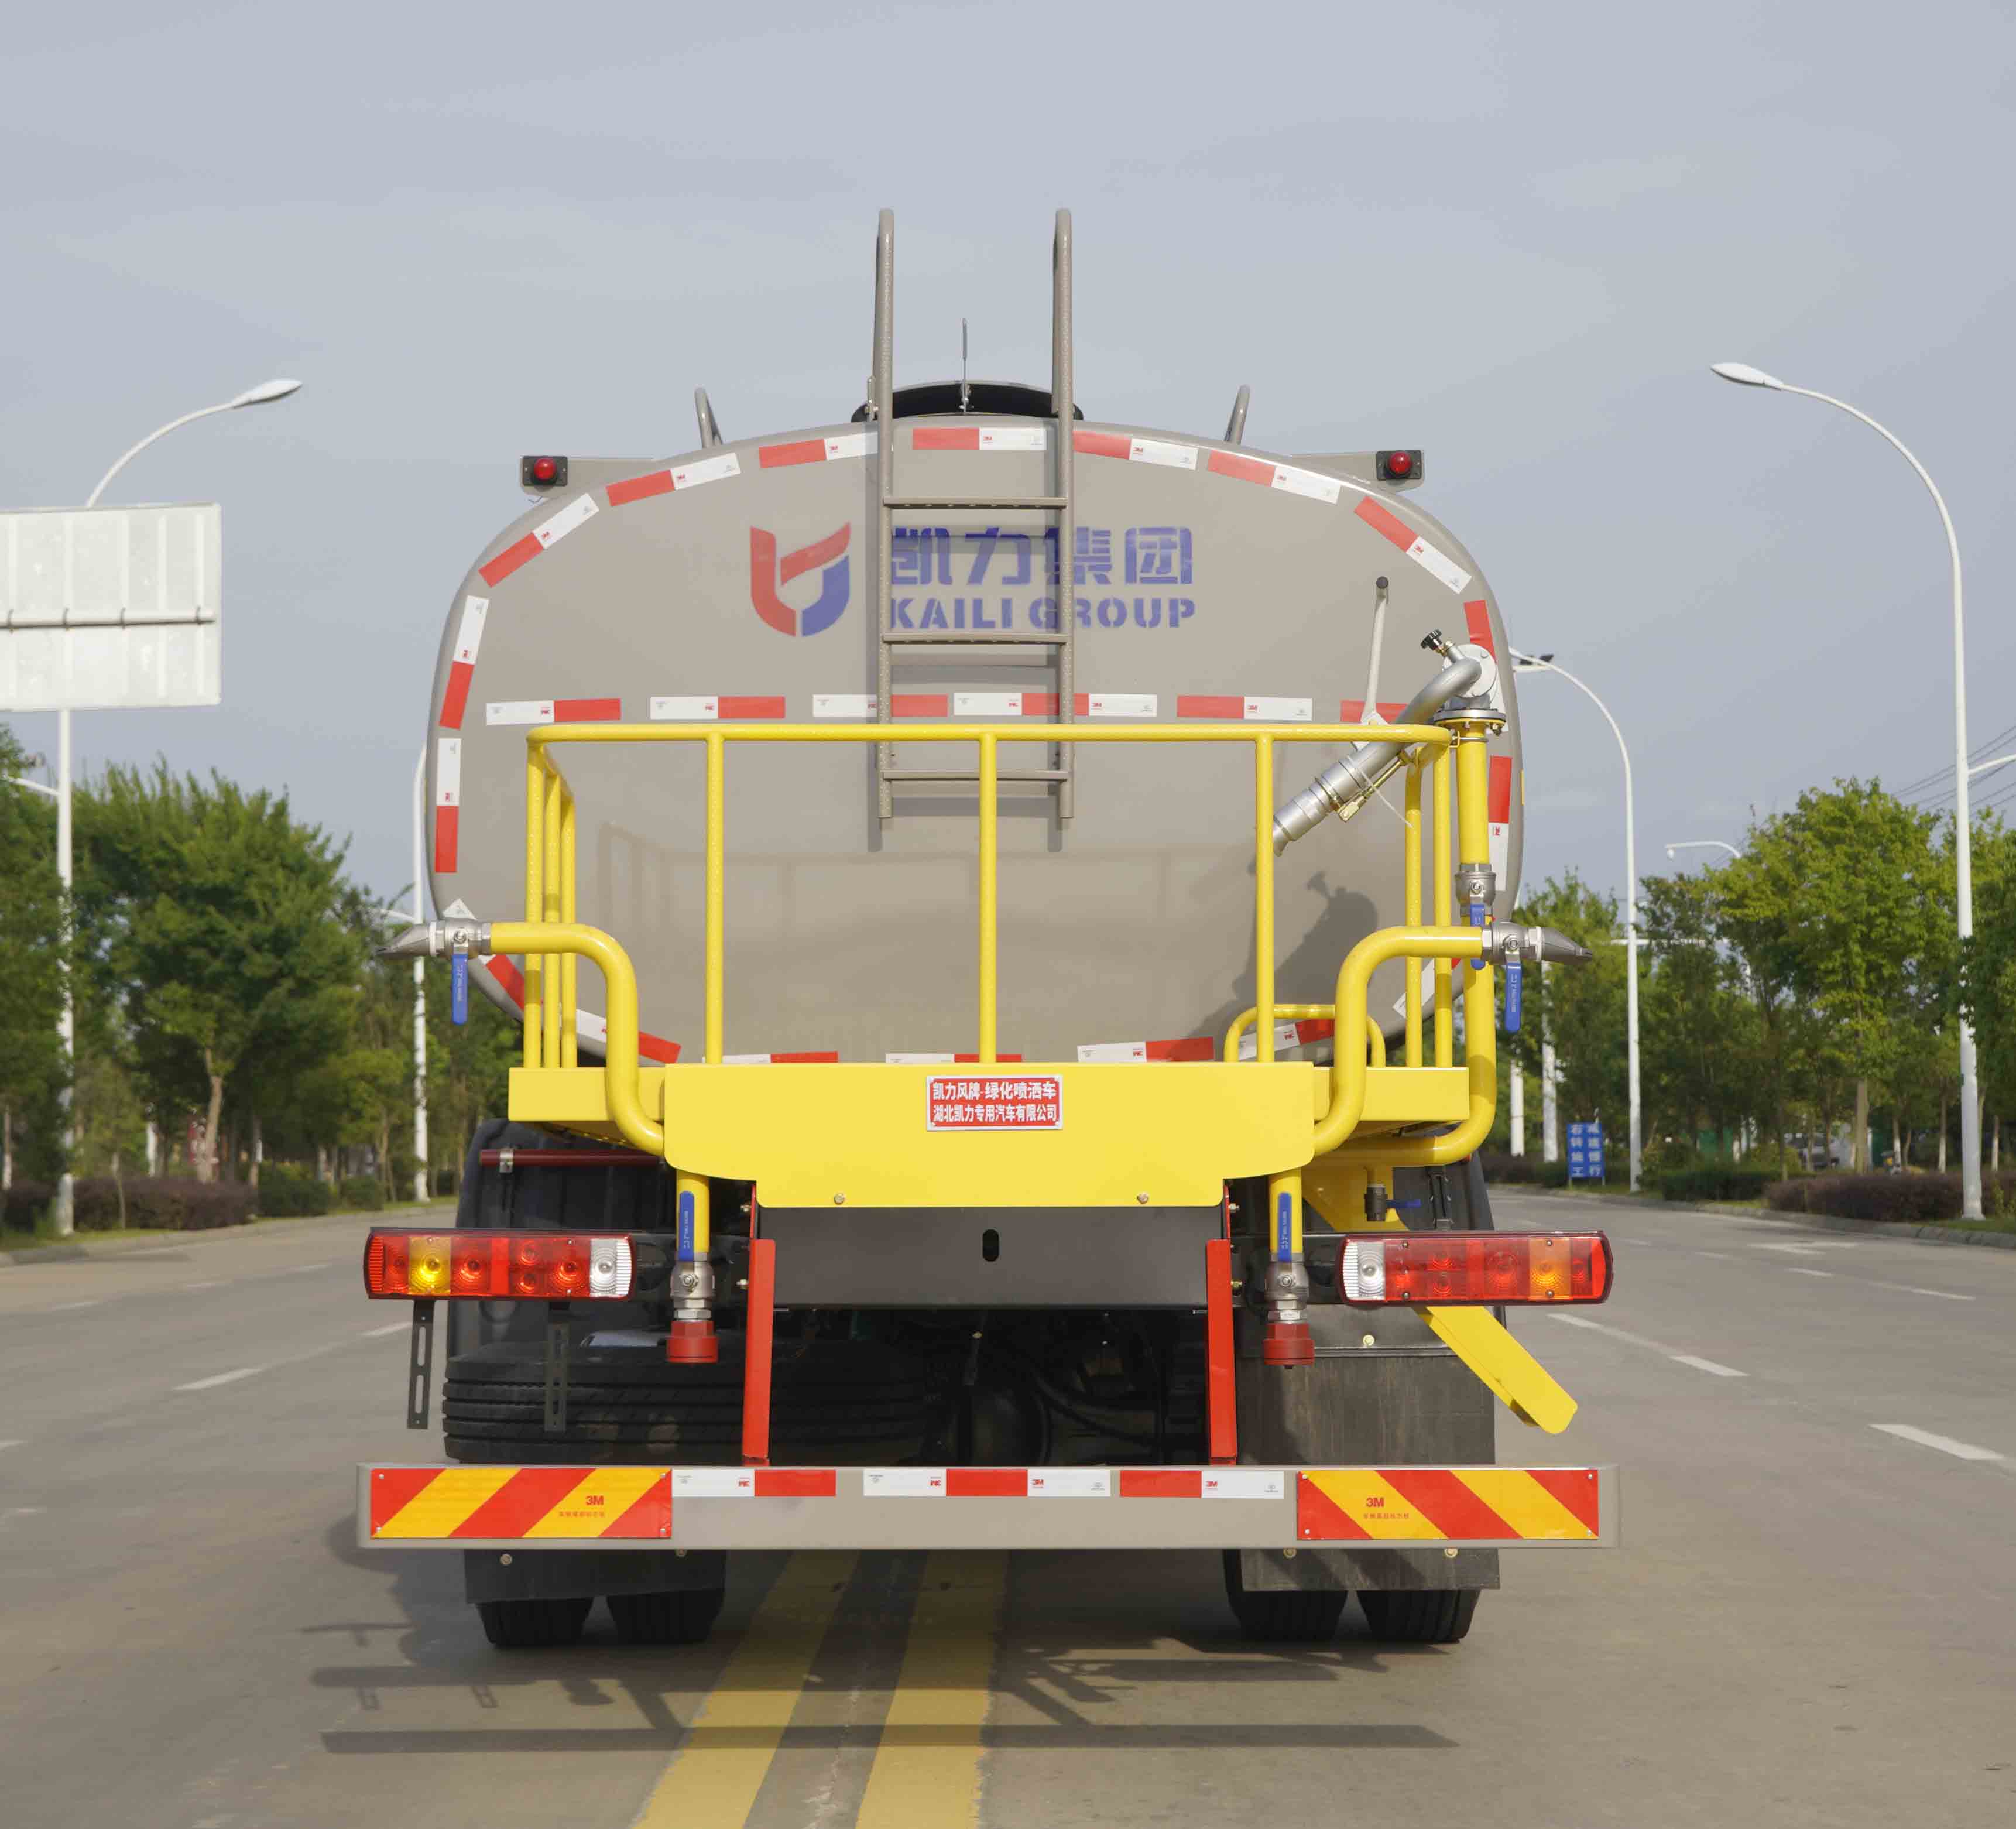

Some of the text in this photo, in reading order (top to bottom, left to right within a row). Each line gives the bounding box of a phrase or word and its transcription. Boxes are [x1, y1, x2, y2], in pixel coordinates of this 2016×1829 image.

[890, 527, 1192, 584] 凯力集团
[890, 597, 1195, 628] KAILI GROUP
[934, 1104, 1057, 1122] 湖北凯力专用汽车有限公司
[586, 1495, 604, 1505] 3M
[1366, 1497, 1384, 1507] 3M
